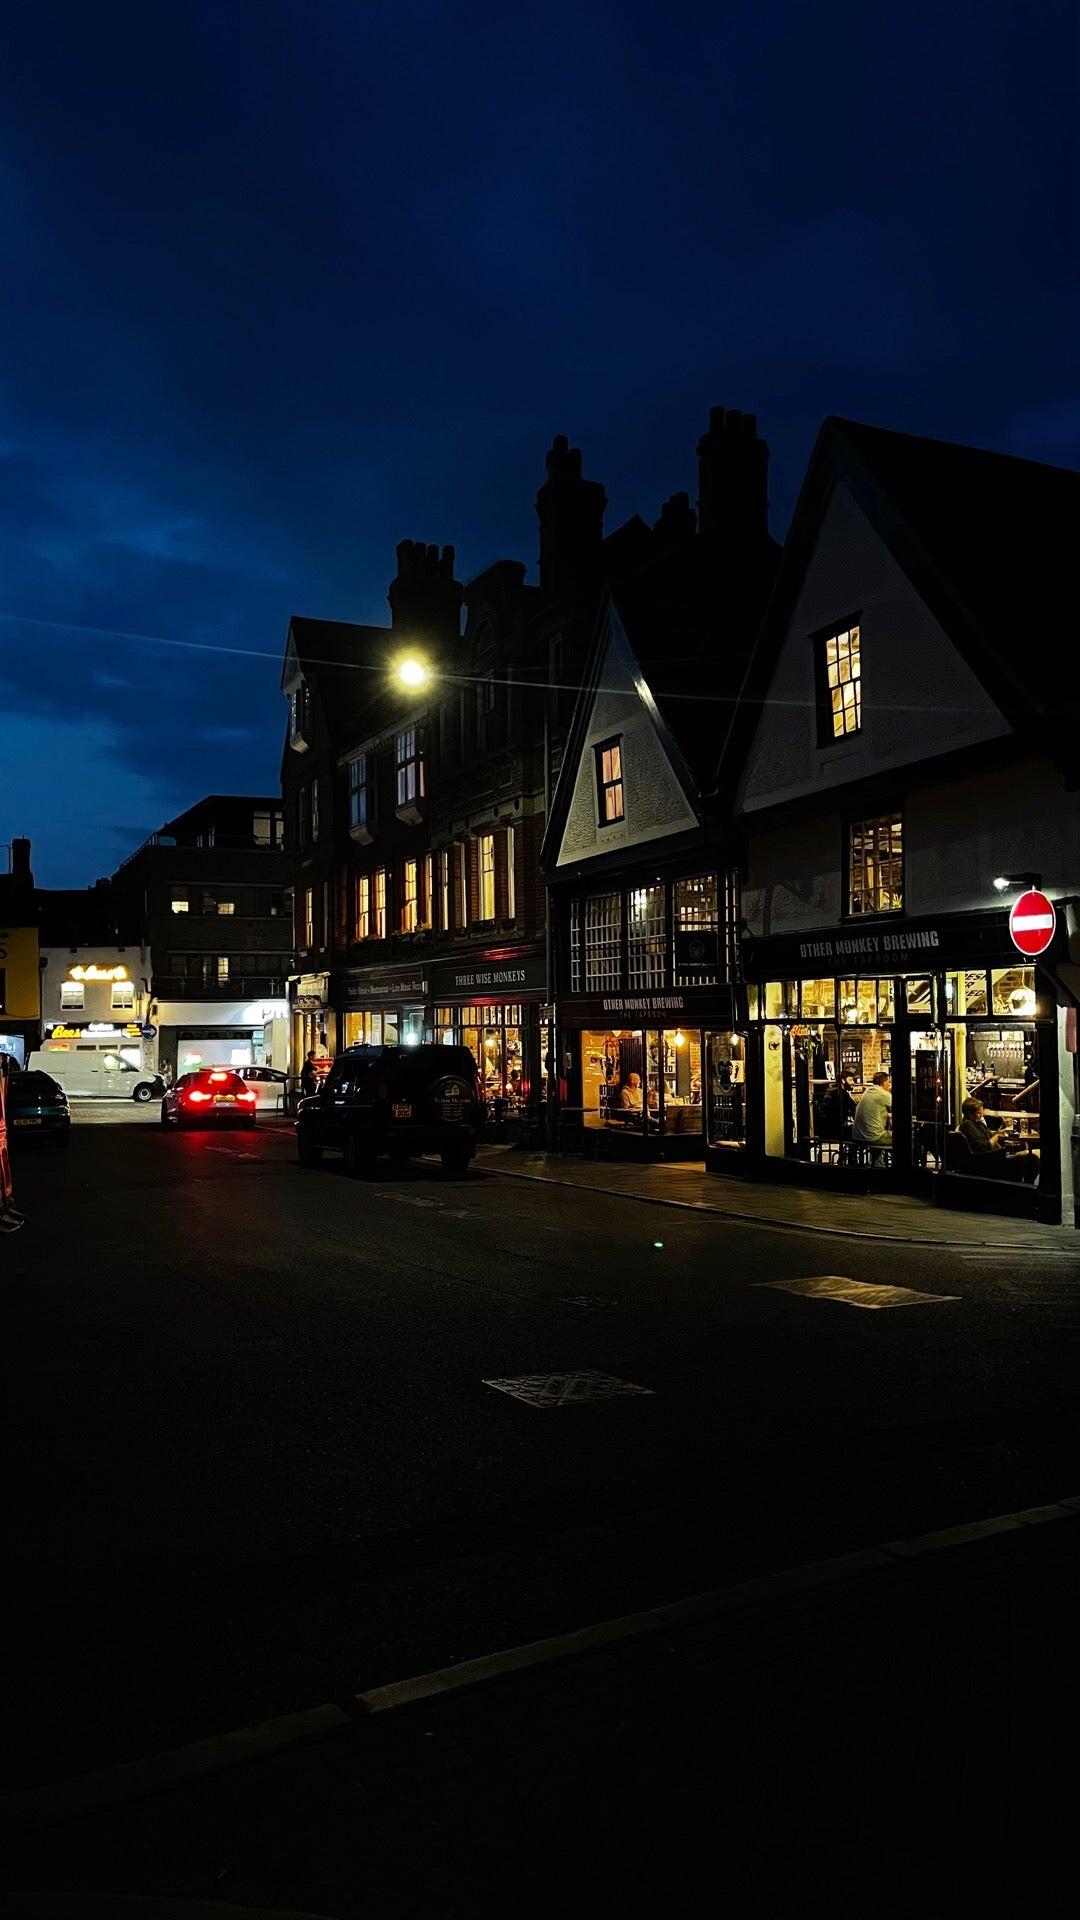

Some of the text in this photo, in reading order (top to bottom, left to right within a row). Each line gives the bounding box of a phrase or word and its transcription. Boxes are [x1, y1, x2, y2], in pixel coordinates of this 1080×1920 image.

[800, 930, 940, 959] OTHER MONKEY BREWING
[853, 952, 912, 967] TAPROOM
[455, 969, 526, 987] THREE WISE MONKEYS
[603, 996, 684, 1011] OTHER MONKEY BREWING
